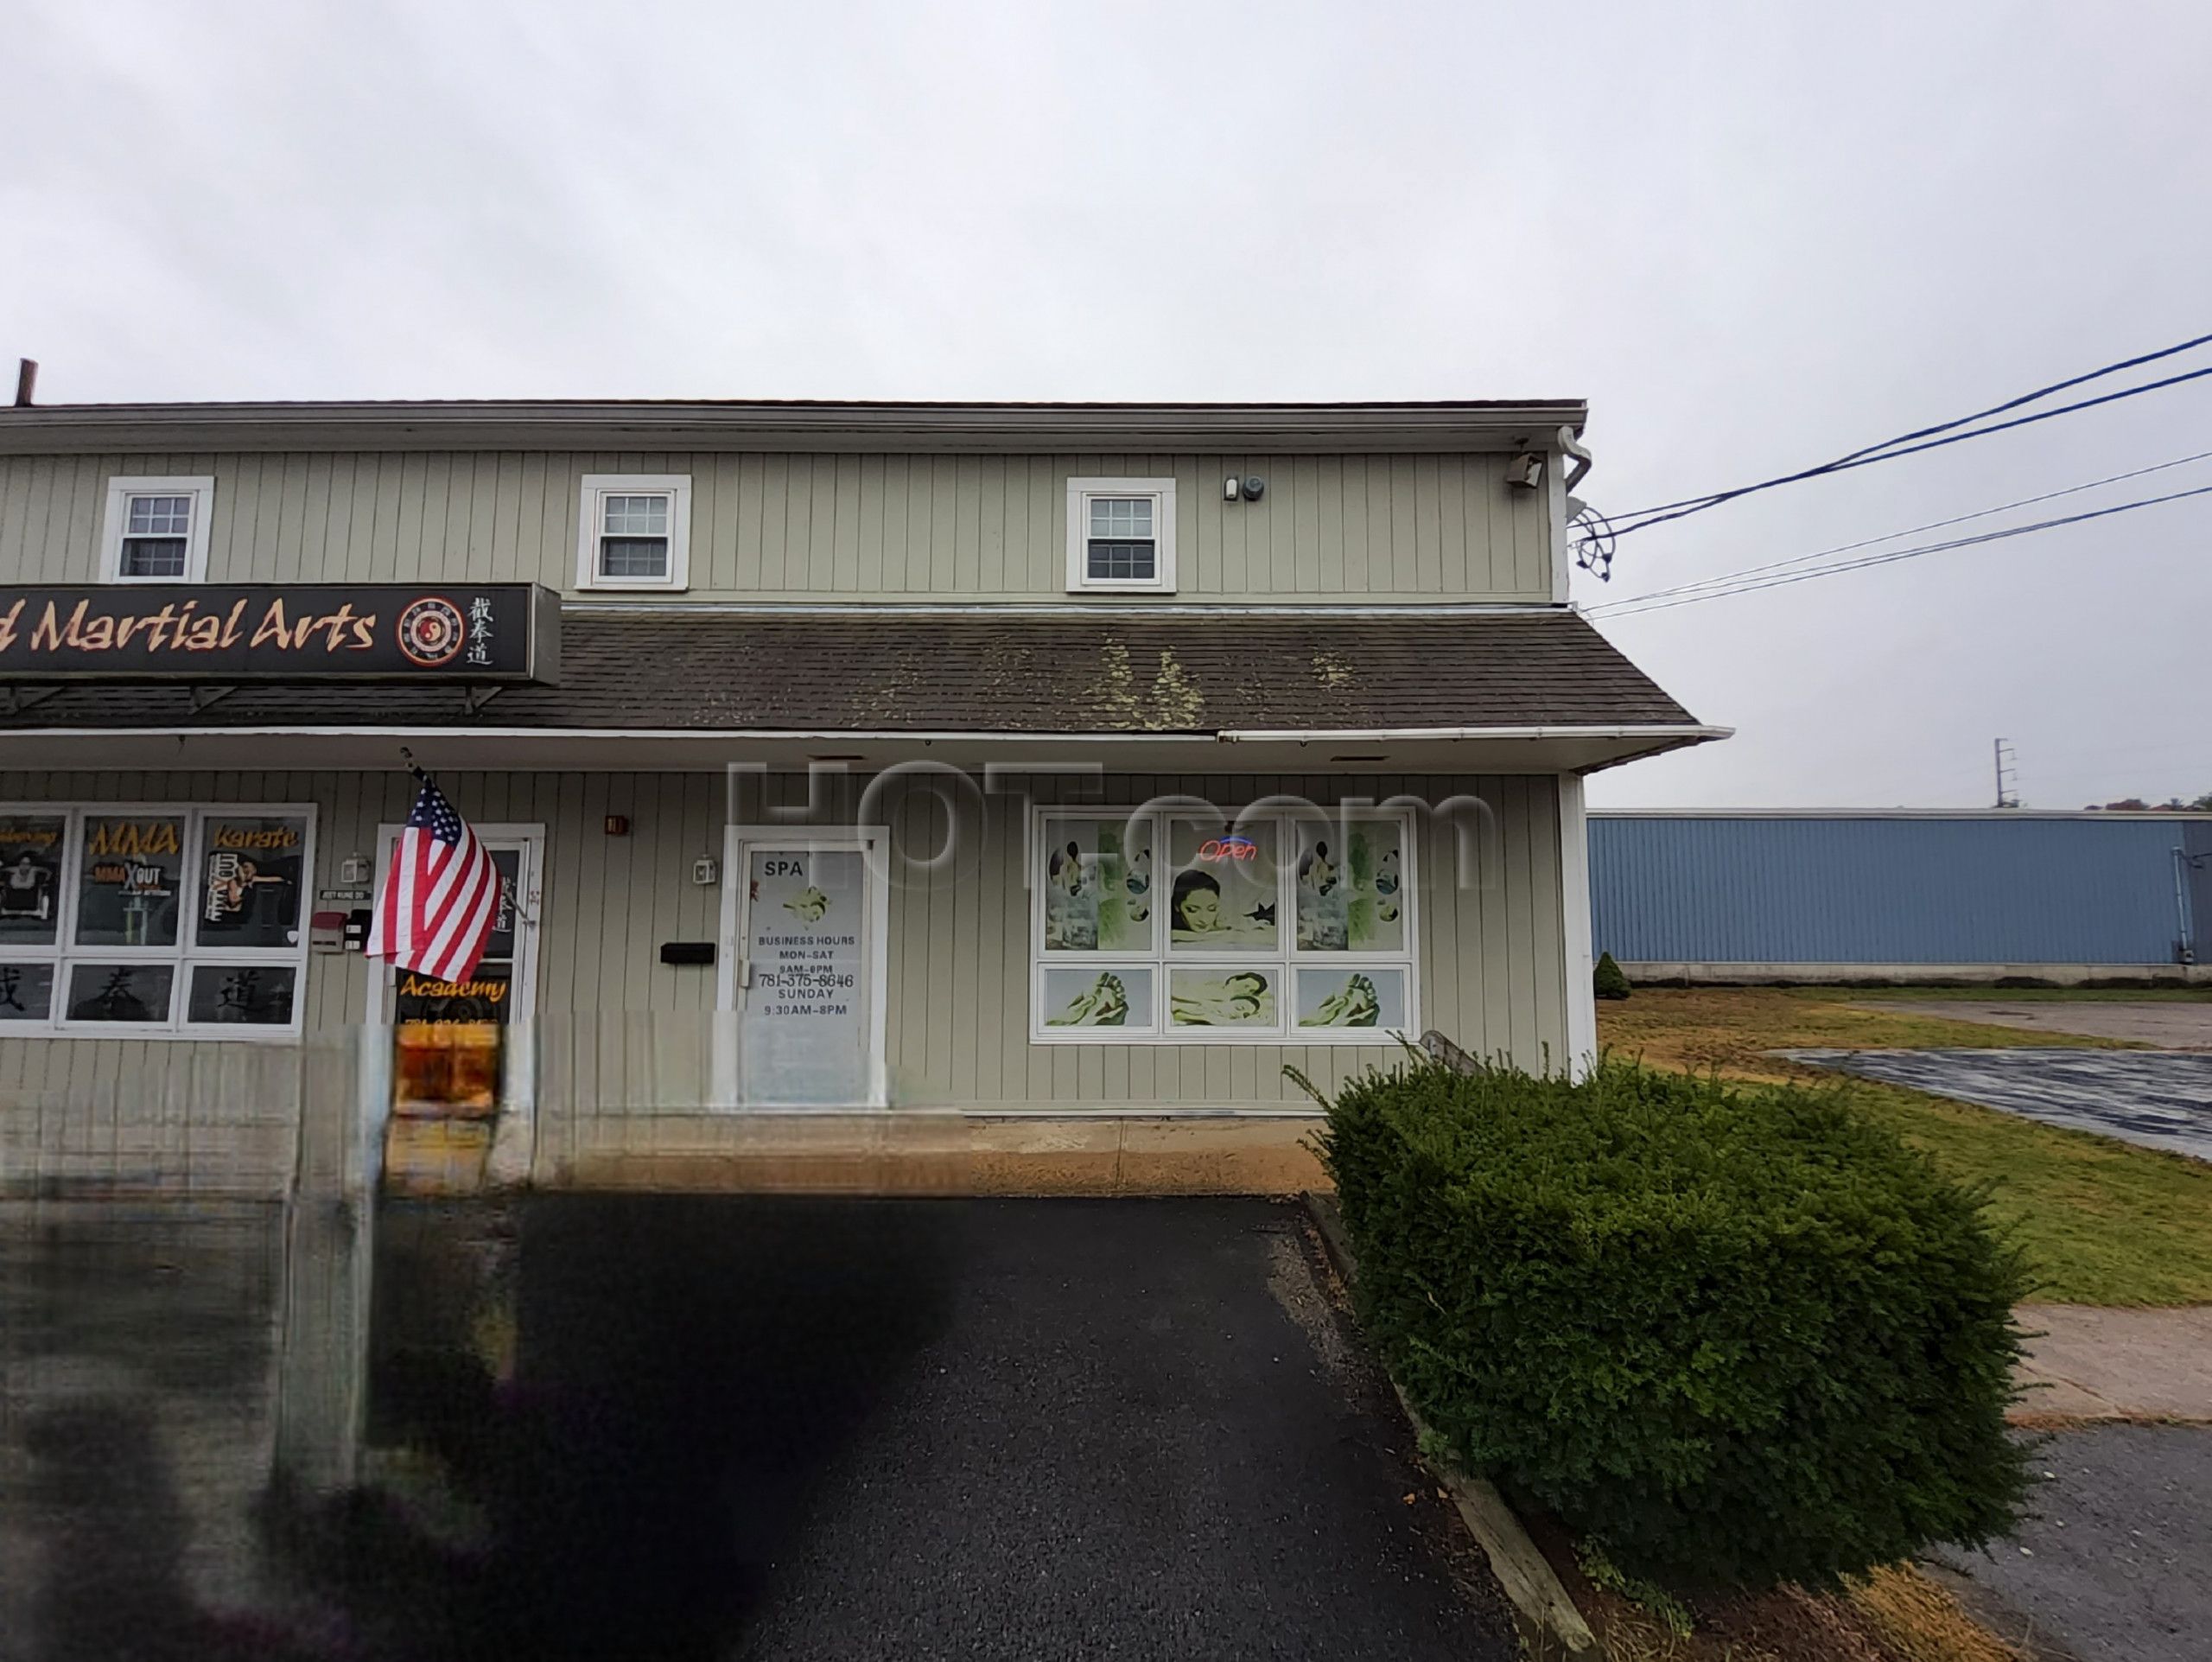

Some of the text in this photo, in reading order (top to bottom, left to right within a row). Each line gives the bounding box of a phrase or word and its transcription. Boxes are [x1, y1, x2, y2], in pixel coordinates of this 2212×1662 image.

[30, 598, 248, 653] Martial
[250, 597, 376, 652] Arts
[88, 822, 179, 856] MMA
[1198, 839, 1257, 863] Open
[764, 861, 804, 876] SPA
[759, 936, 855, 946] BUSINESS HOURS
[779, 951, 835, 959] MON-SAT
[400, 974, 506, 1003] Academy
[778, 989, 835, 999] SUNDAY
